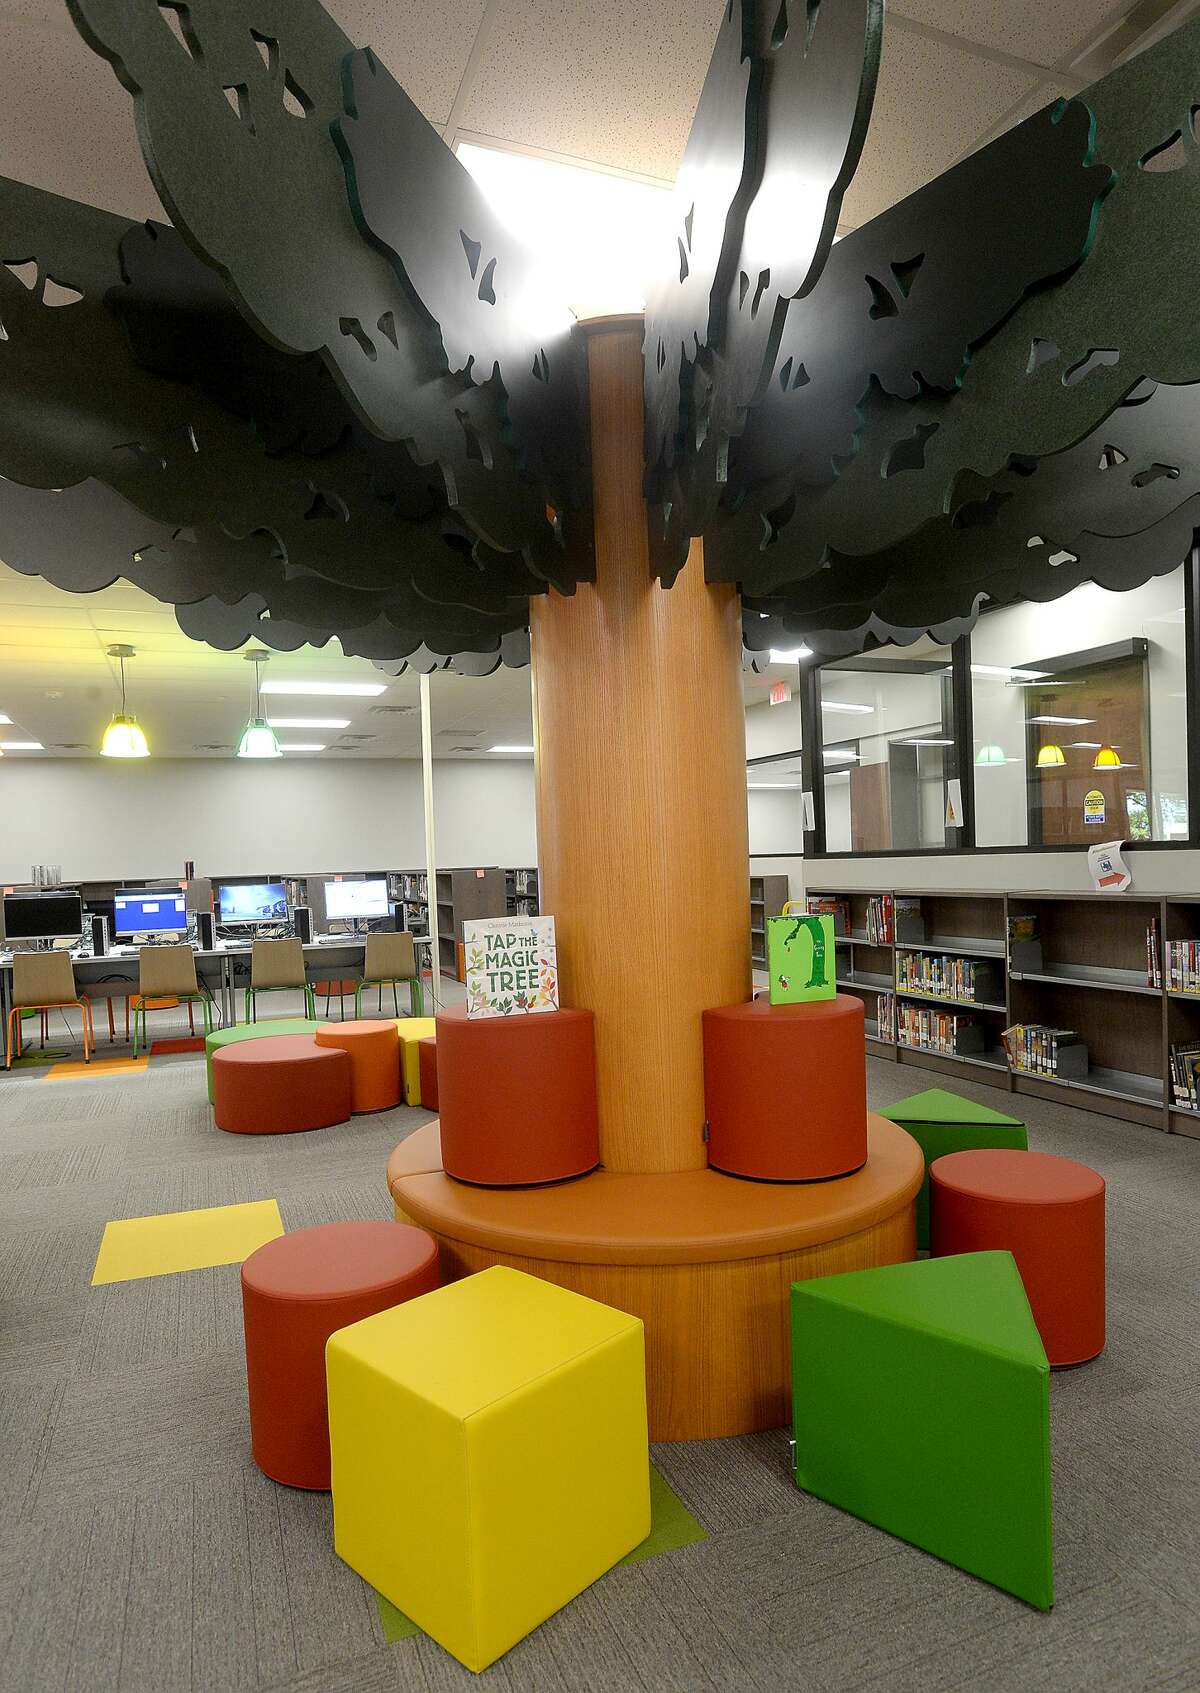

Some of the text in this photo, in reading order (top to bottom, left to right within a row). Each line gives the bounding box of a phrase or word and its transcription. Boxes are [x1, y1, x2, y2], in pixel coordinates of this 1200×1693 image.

[484, 933, 538, 951] TAP THE
[485, 949, 539, 970] MAGIC
[487, 969, 540, 993] TREE
